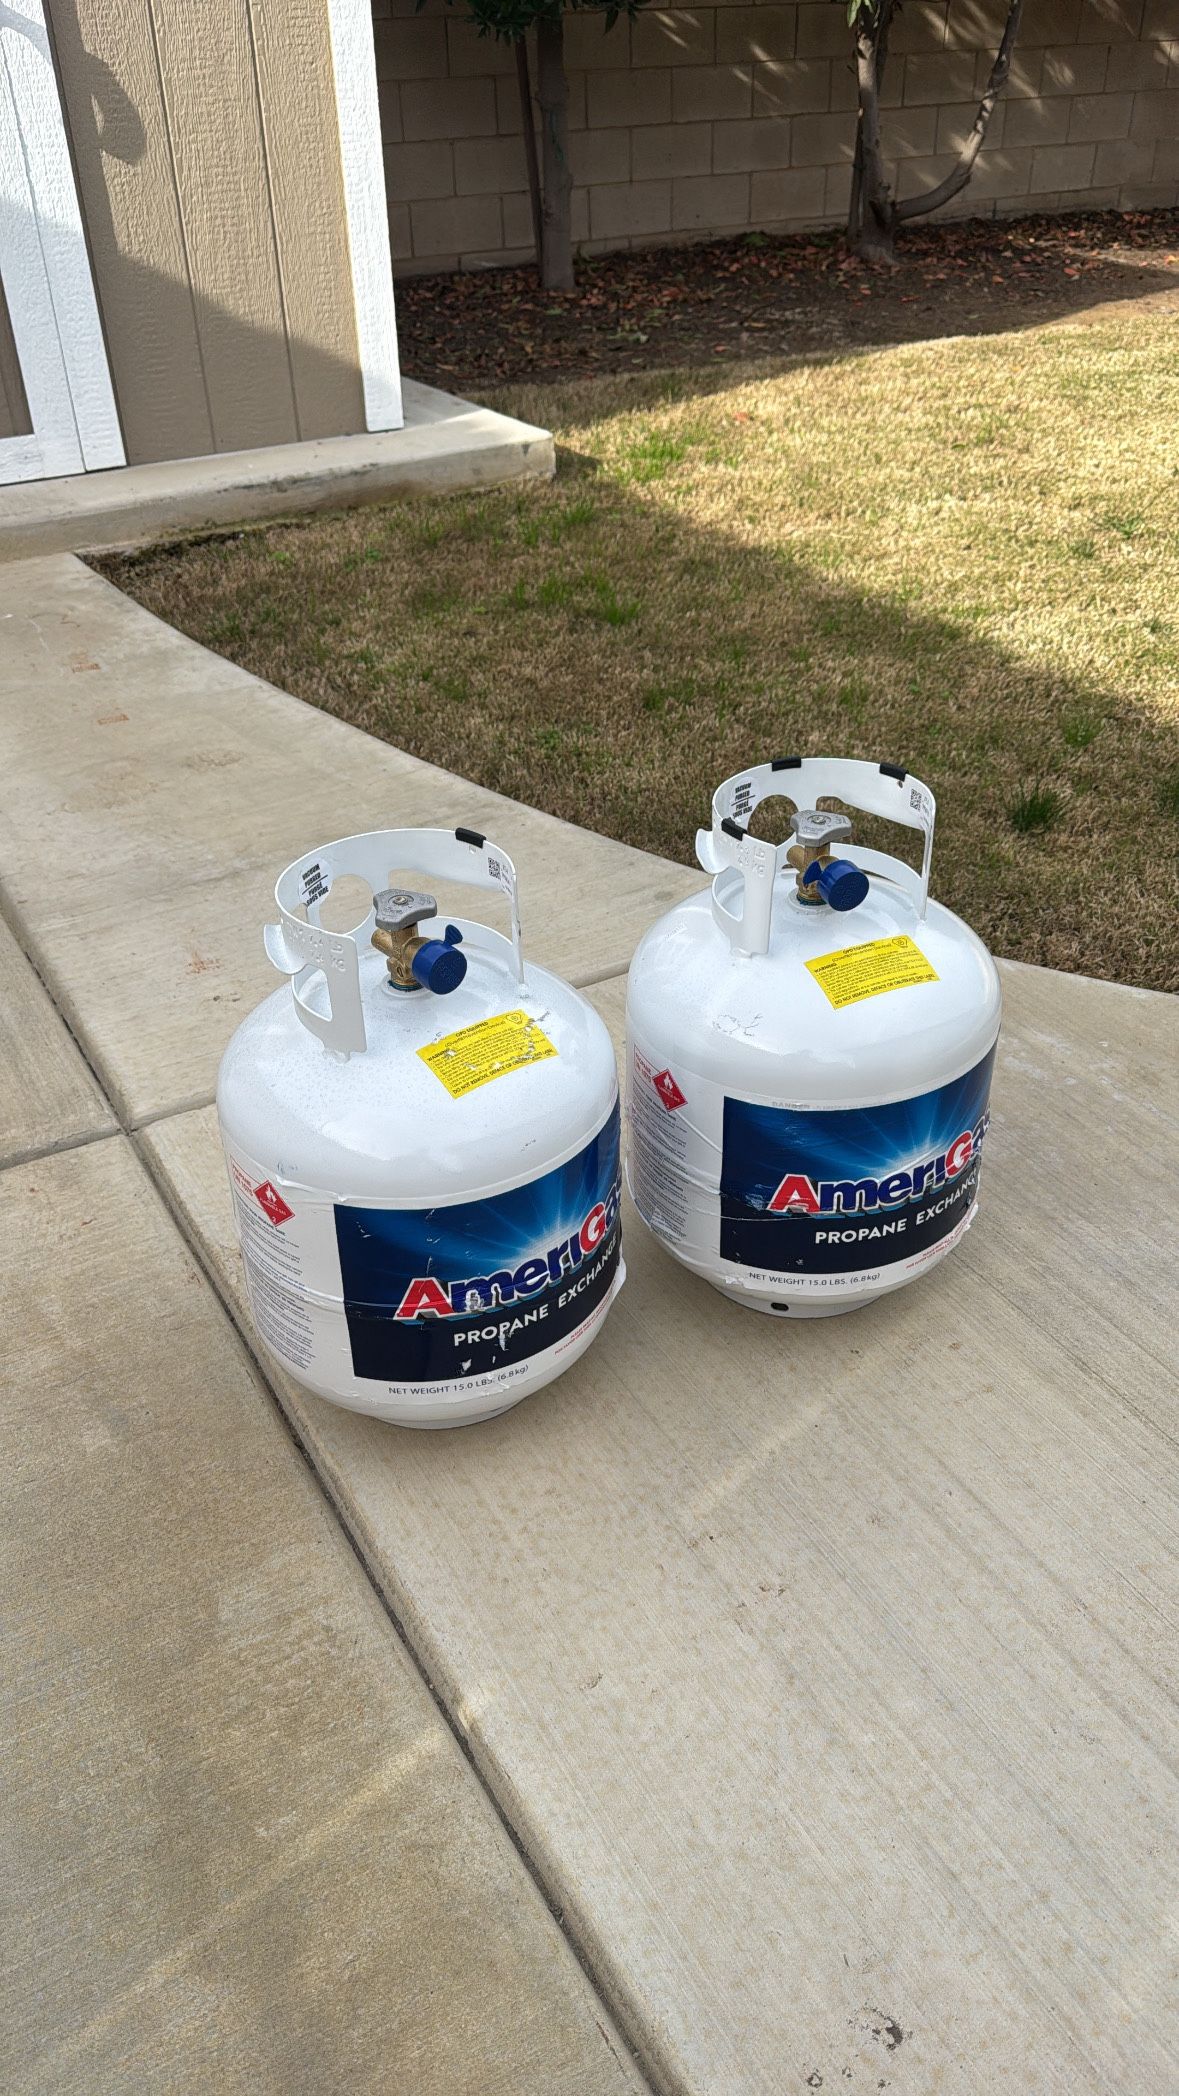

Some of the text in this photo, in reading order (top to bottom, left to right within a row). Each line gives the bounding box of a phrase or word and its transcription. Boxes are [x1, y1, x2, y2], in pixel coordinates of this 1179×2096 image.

[302, 864, 321, 881] VACUUM
[815, 1218, 907, 1244] PROPANE
[749, 1272, 766, 1281] NET
[769, 1276, 805, 1286] WEIGHT
[829, 1278, 847, 1286] LBS.
[454, 1304, 549, 1347] PROPANE
[558, 1231, 617, 1309] EXCHANGE
[388, 1386, 408, 1395] NET
[410, 1385, 450, 1395] WEIGHT
[453, 1382, 473, 1392] 15.0
